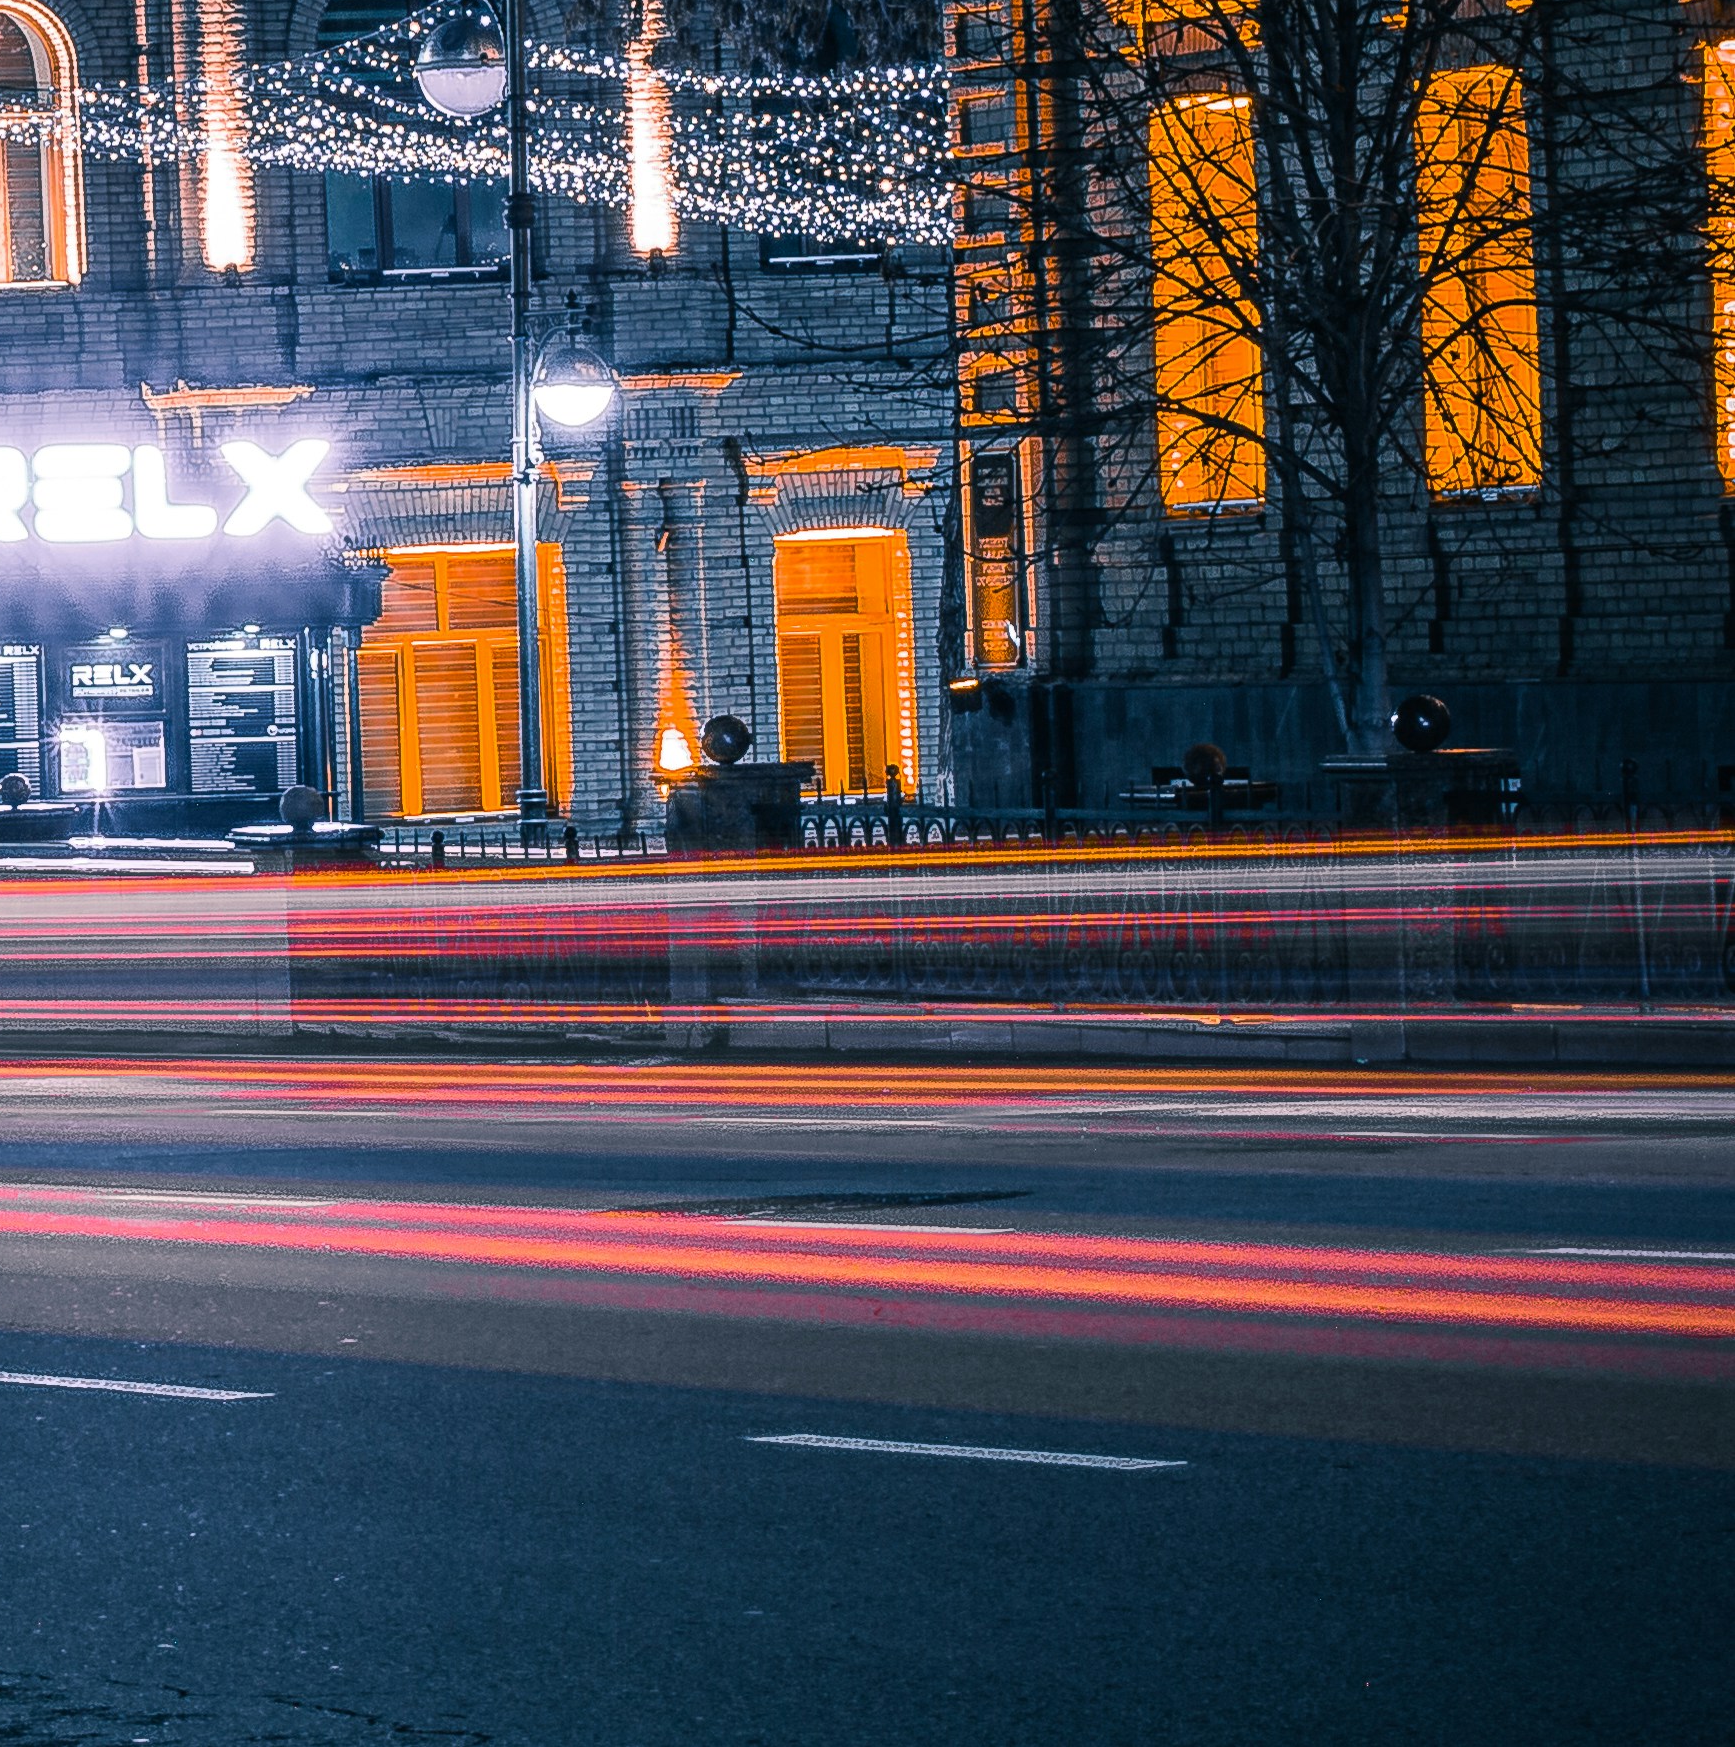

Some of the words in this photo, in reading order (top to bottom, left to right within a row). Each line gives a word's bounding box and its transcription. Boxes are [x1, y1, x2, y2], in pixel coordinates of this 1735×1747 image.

[260, 638, 296, 649] RELX
[3, 645, 39, 656] RELX
[72, 664, 153, 686] RELX
